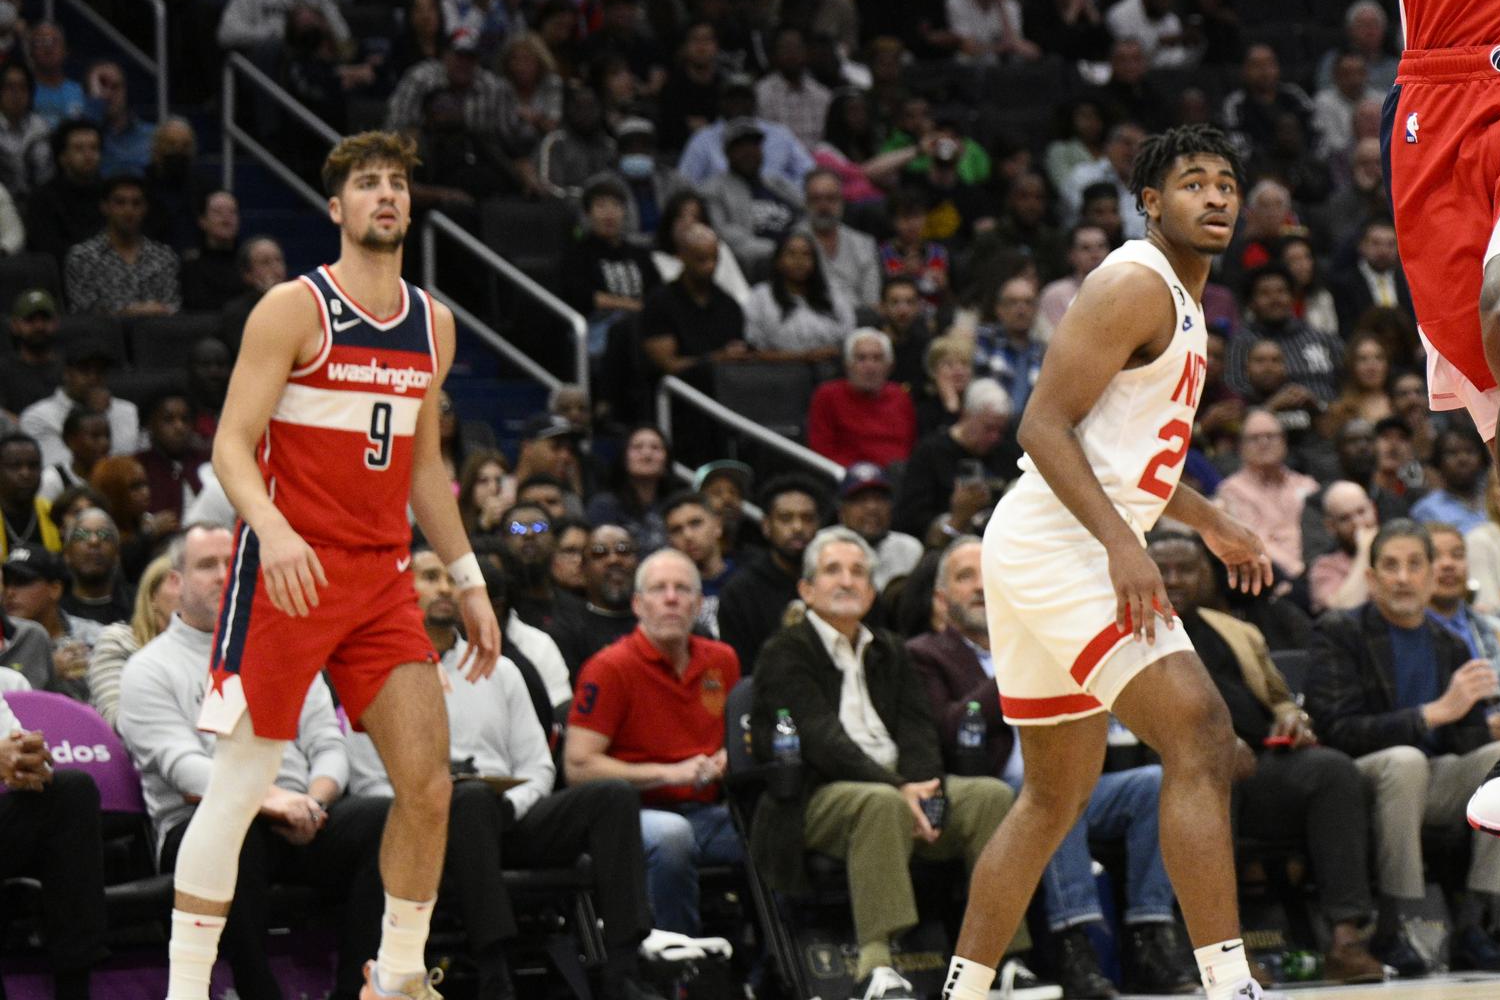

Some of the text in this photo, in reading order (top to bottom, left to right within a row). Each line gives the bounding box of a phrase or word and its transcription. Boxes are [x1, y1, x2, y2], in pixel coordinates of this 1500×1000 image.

[327, 357, 433, 393] washington
[364, 401, 393, 472] 9
[1137, 419, 1191, 500] 2
[577, 682, 598, 715] 3
[43, 740, 111, 764] dos
